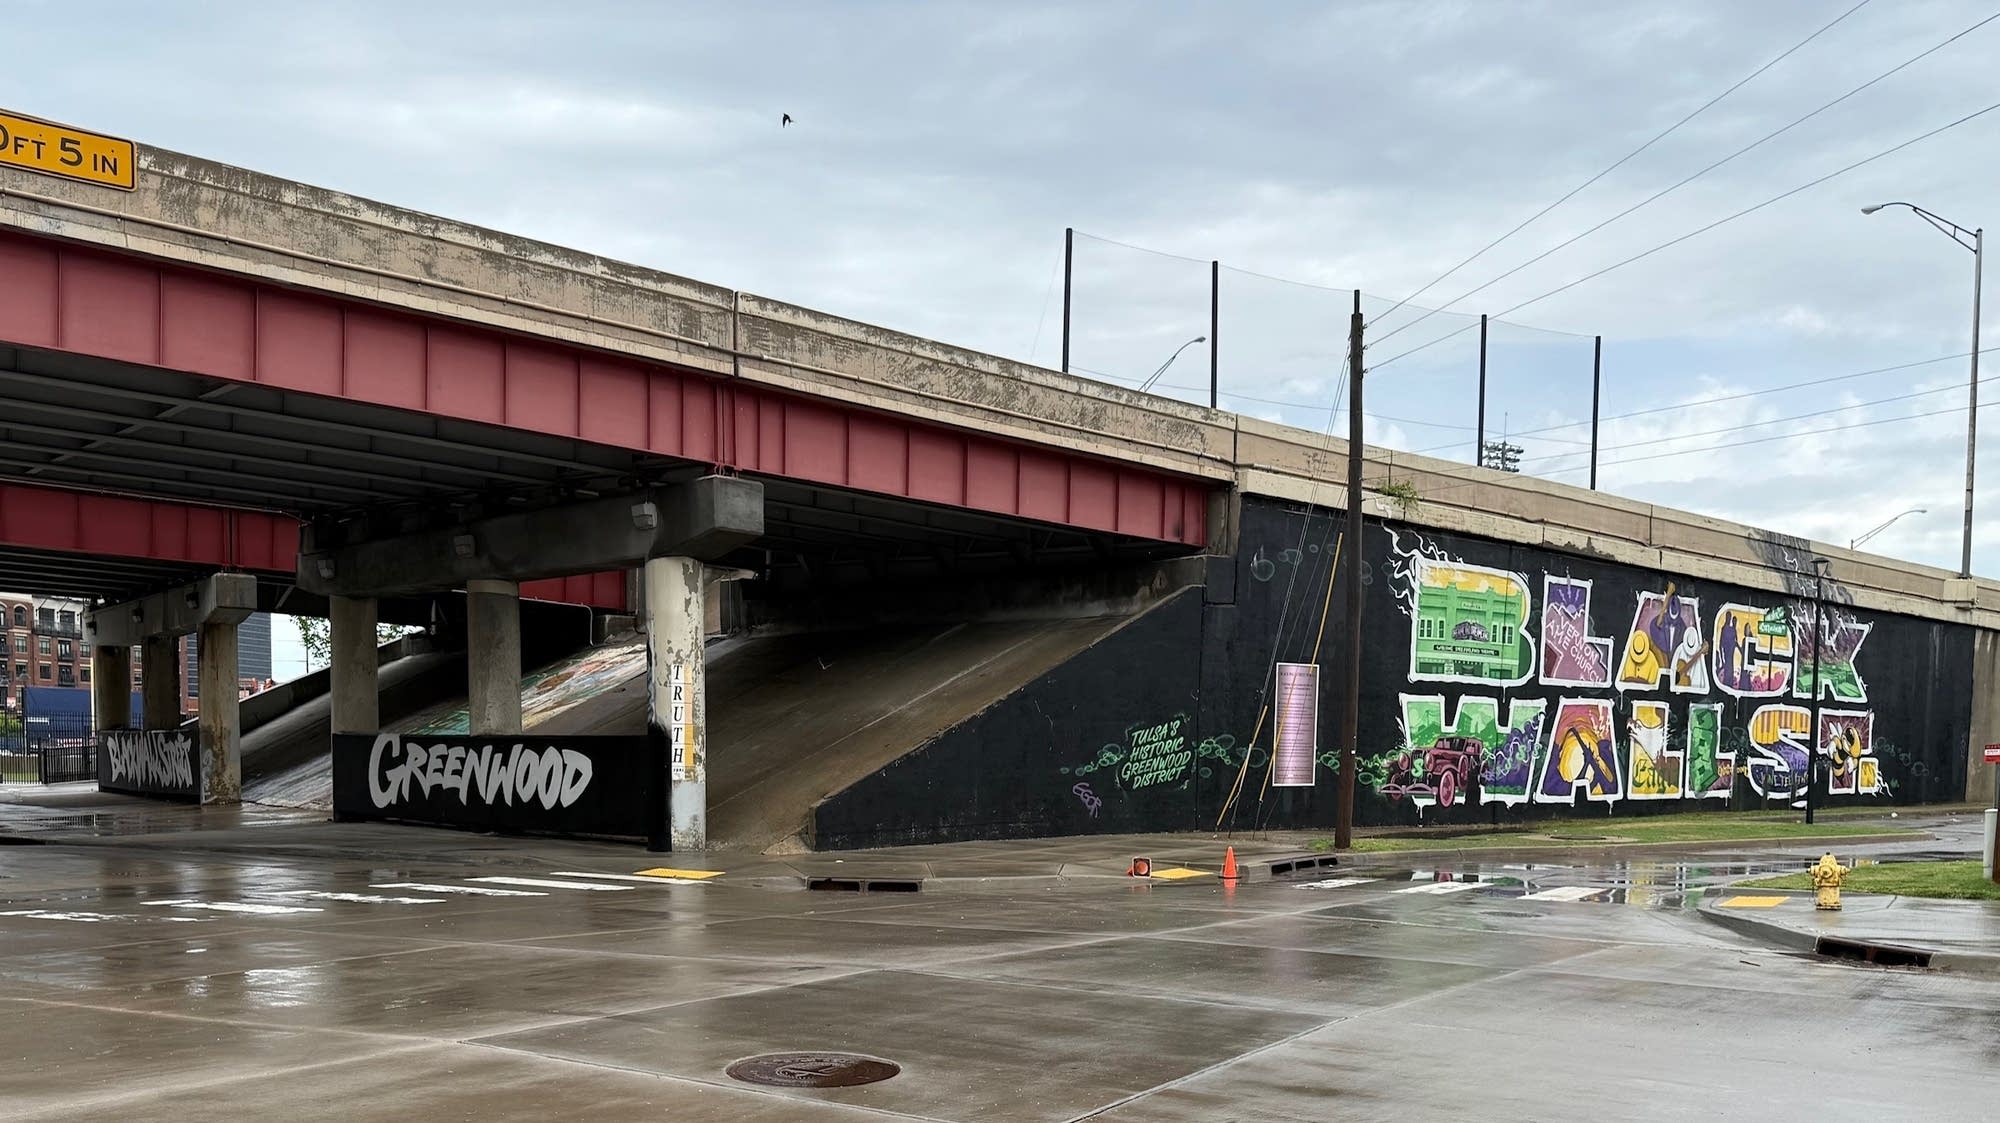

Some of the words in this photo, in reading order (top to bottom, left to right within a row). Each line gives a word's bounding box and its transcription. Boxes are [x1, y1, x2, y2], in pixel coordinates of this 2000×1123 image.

[59, 137, 83, 166] 5
[93, 153, 118, 176] IN
[1408, 553, 1872, 704] BLACK
[1545, 620, 1570, 651] AME
[1561, 616, 1598, 665] VERNON
[673, 665, 684, 763] TRUTH
[1131, 719, 1181, 746] TULSA'S
[1121, 750, 1192, 782] GREENWOOD
[1129, 737, 1184, 762] HISTORIC
[1398, 690, 1737, 805] WALL
[368, 733, 593, 810] GREENWOOD
[1132, 766, 1186, 790] DISTRICT
